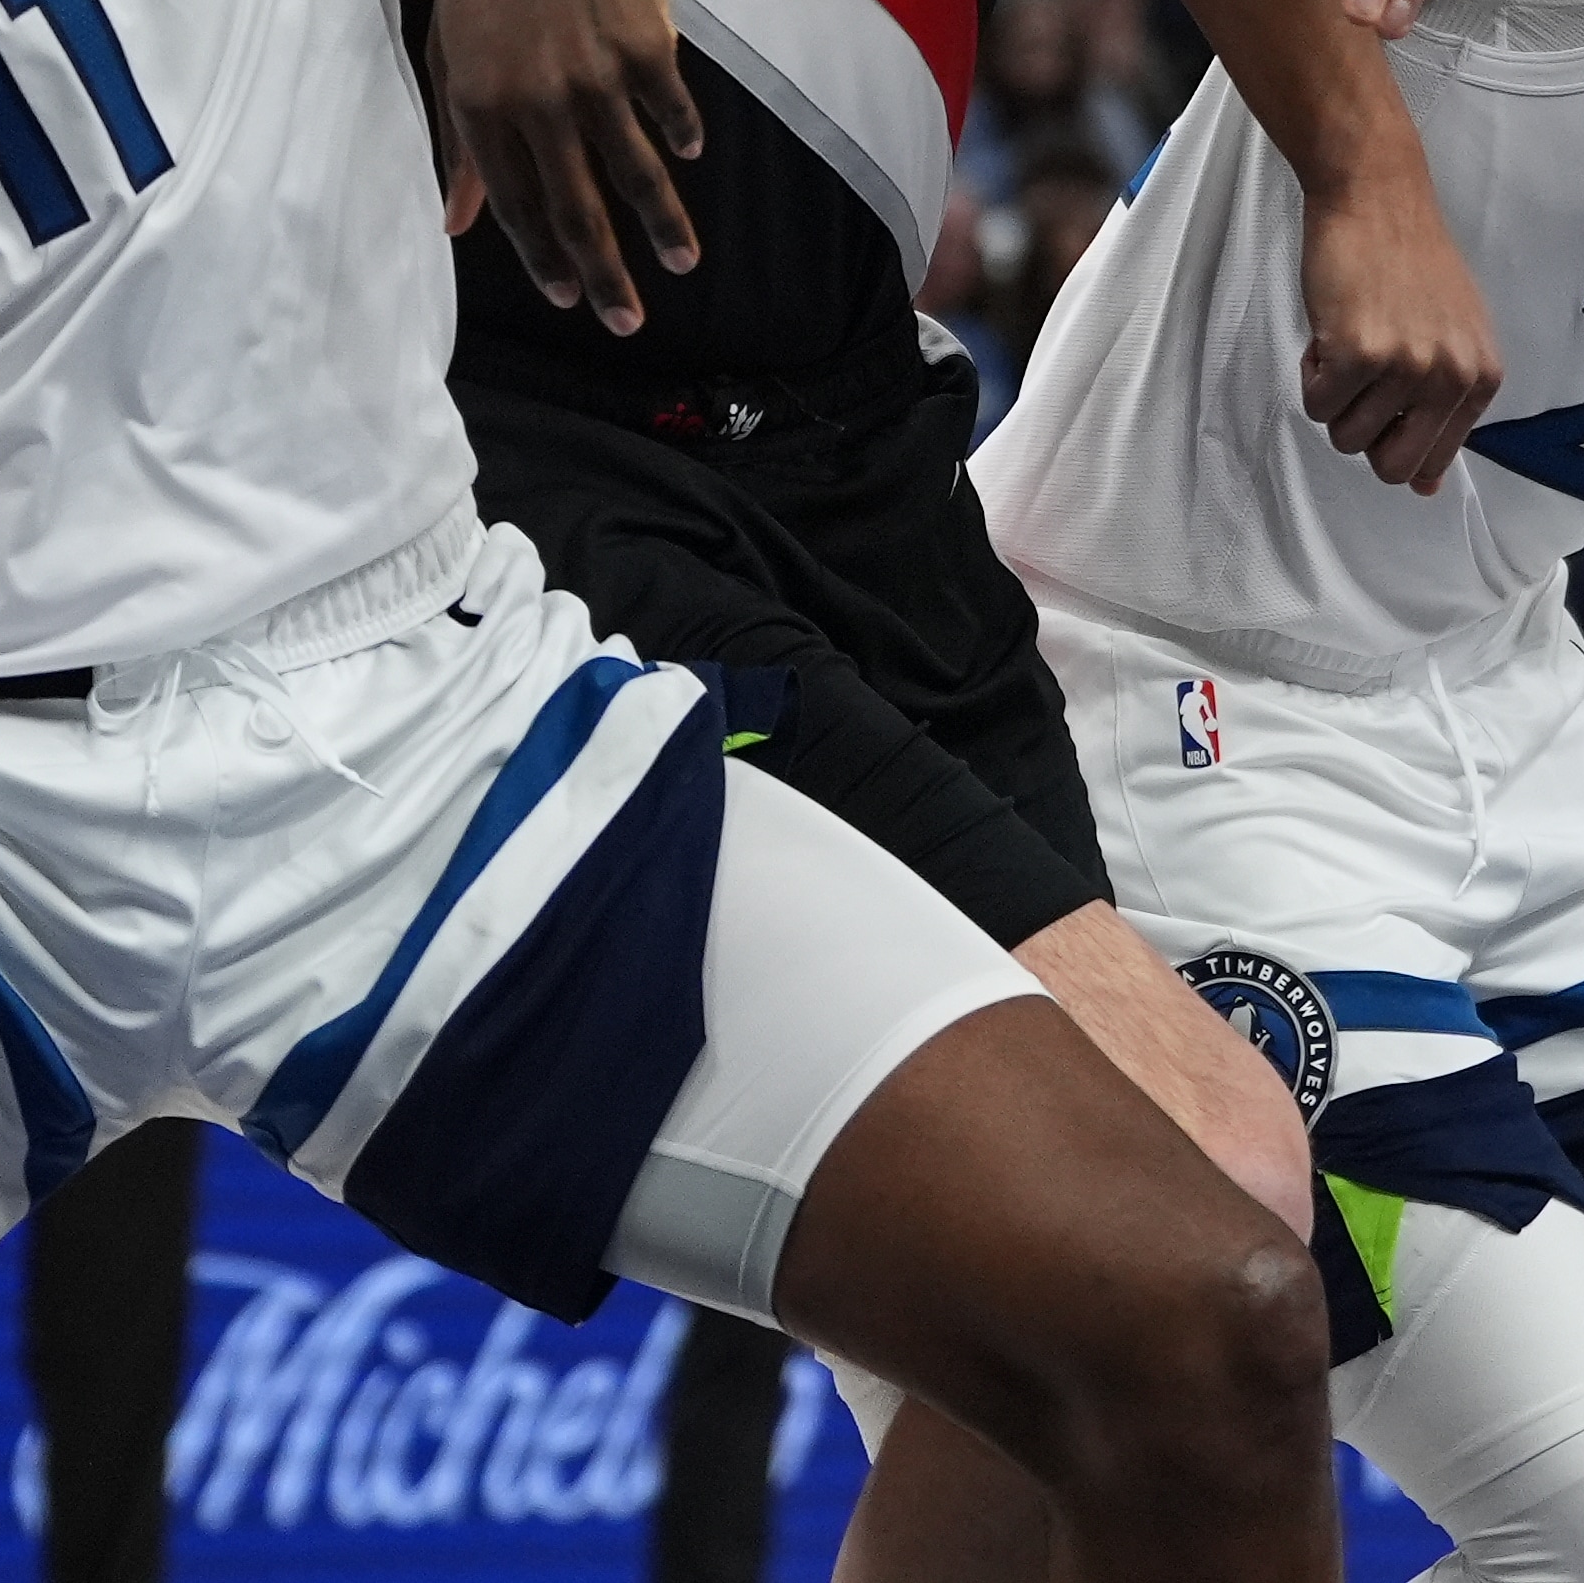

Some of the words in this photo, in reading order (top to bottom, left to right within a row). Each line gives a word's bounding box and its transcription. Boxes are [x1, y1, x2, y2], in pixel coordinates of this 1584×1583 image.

[1186, 750, 1207, 766] NBA
[1205, 957, 1328, 1107] TIMBERWOLVES
[162, 1250, 822, 1532] Michel
